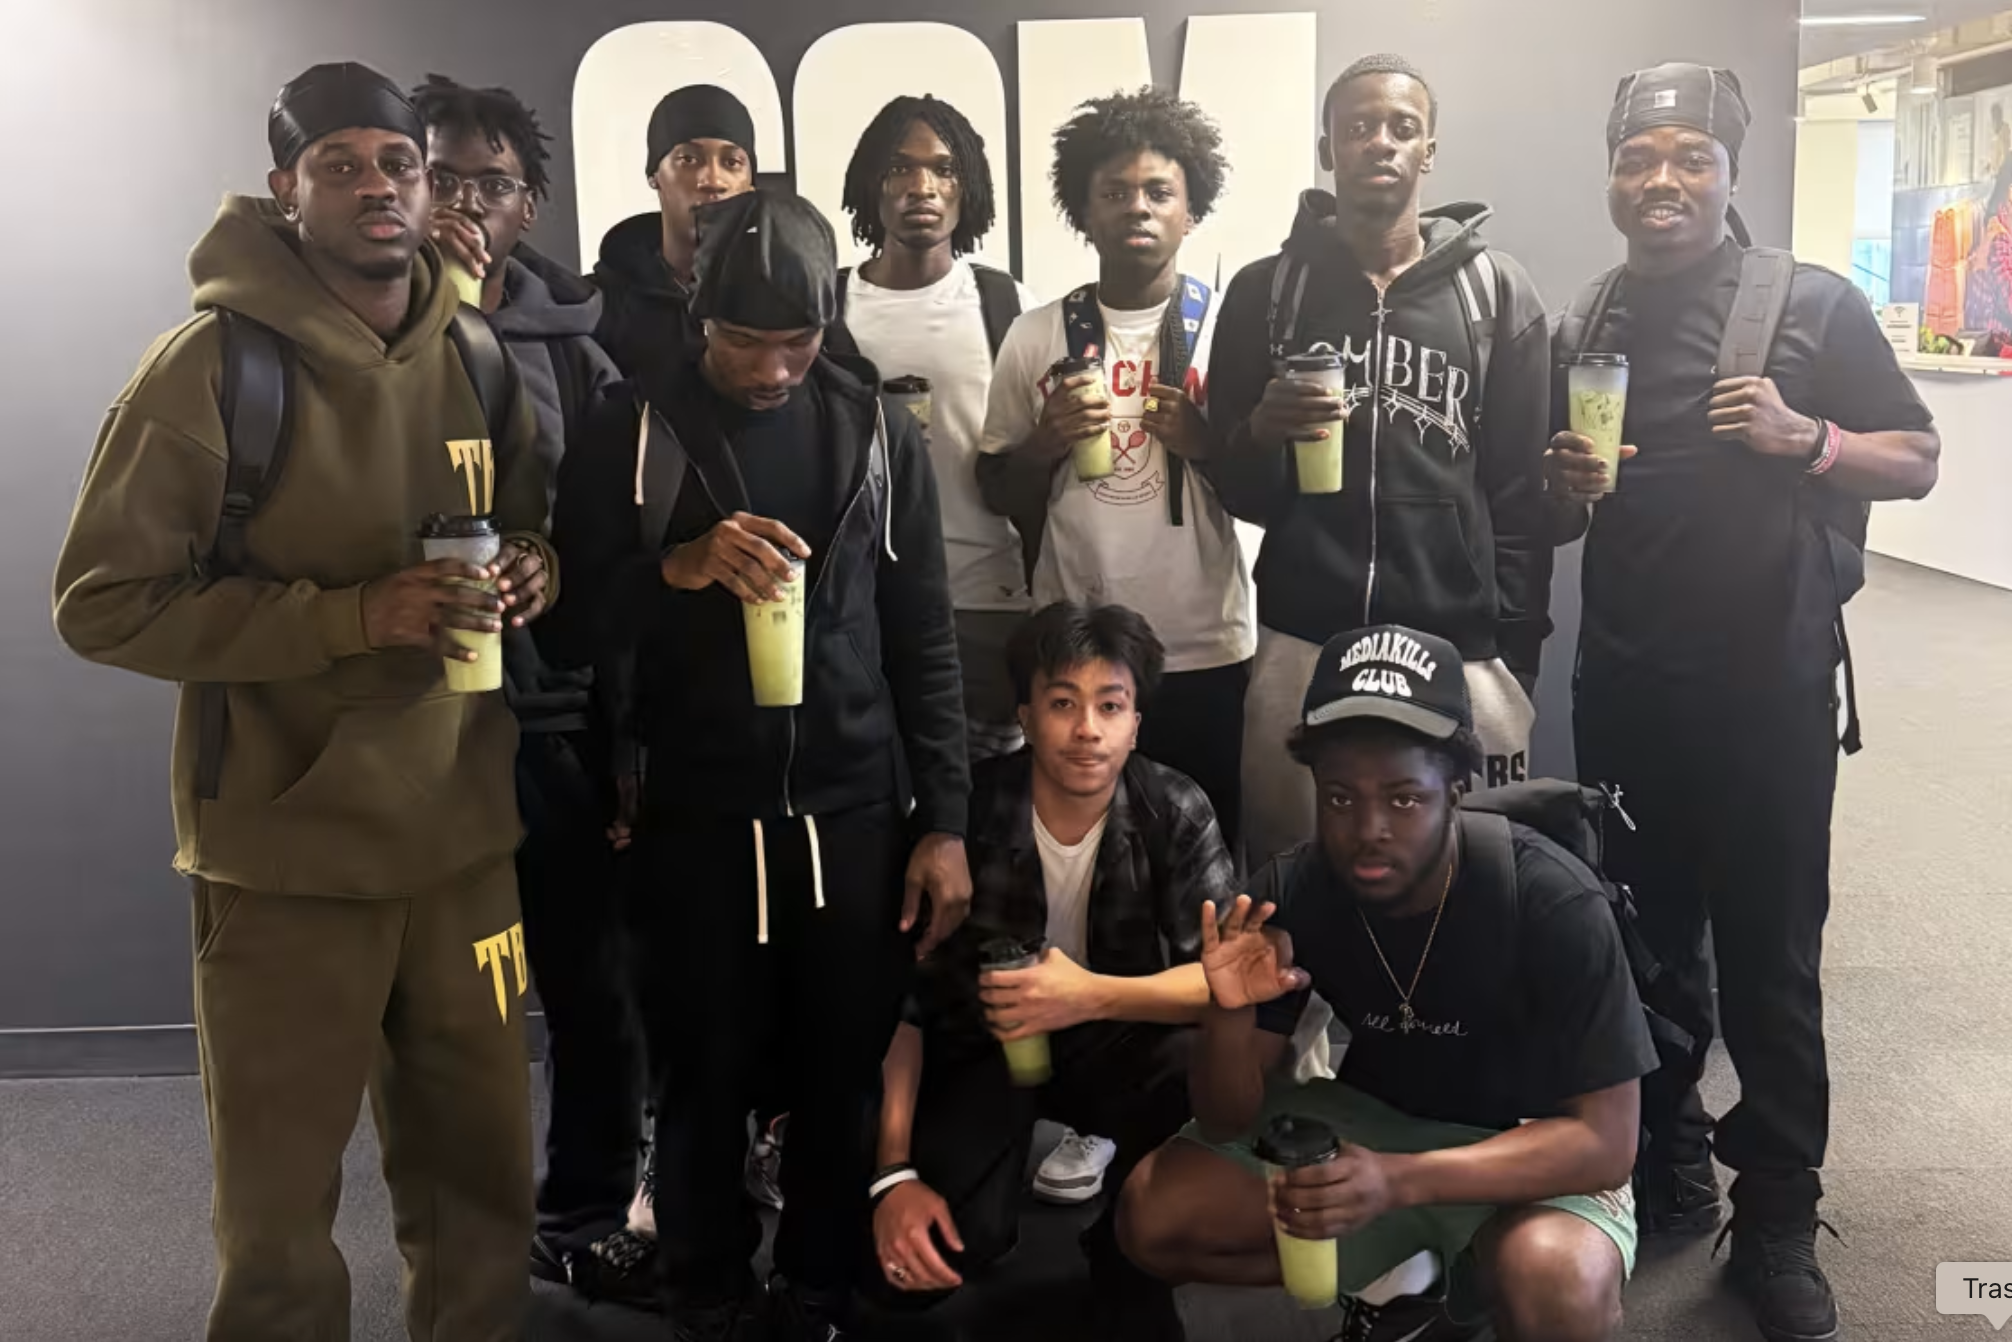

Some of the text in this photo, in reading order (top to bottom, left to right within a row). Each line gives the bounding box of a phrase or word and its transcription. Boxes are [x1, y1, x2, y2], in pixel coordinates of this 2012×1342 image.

[1308, 334, 1469, 434] MBER
[1339, 631, 1437, 682] MEDIAKILLS
[1351, 668, 1413, 697] CLUB
